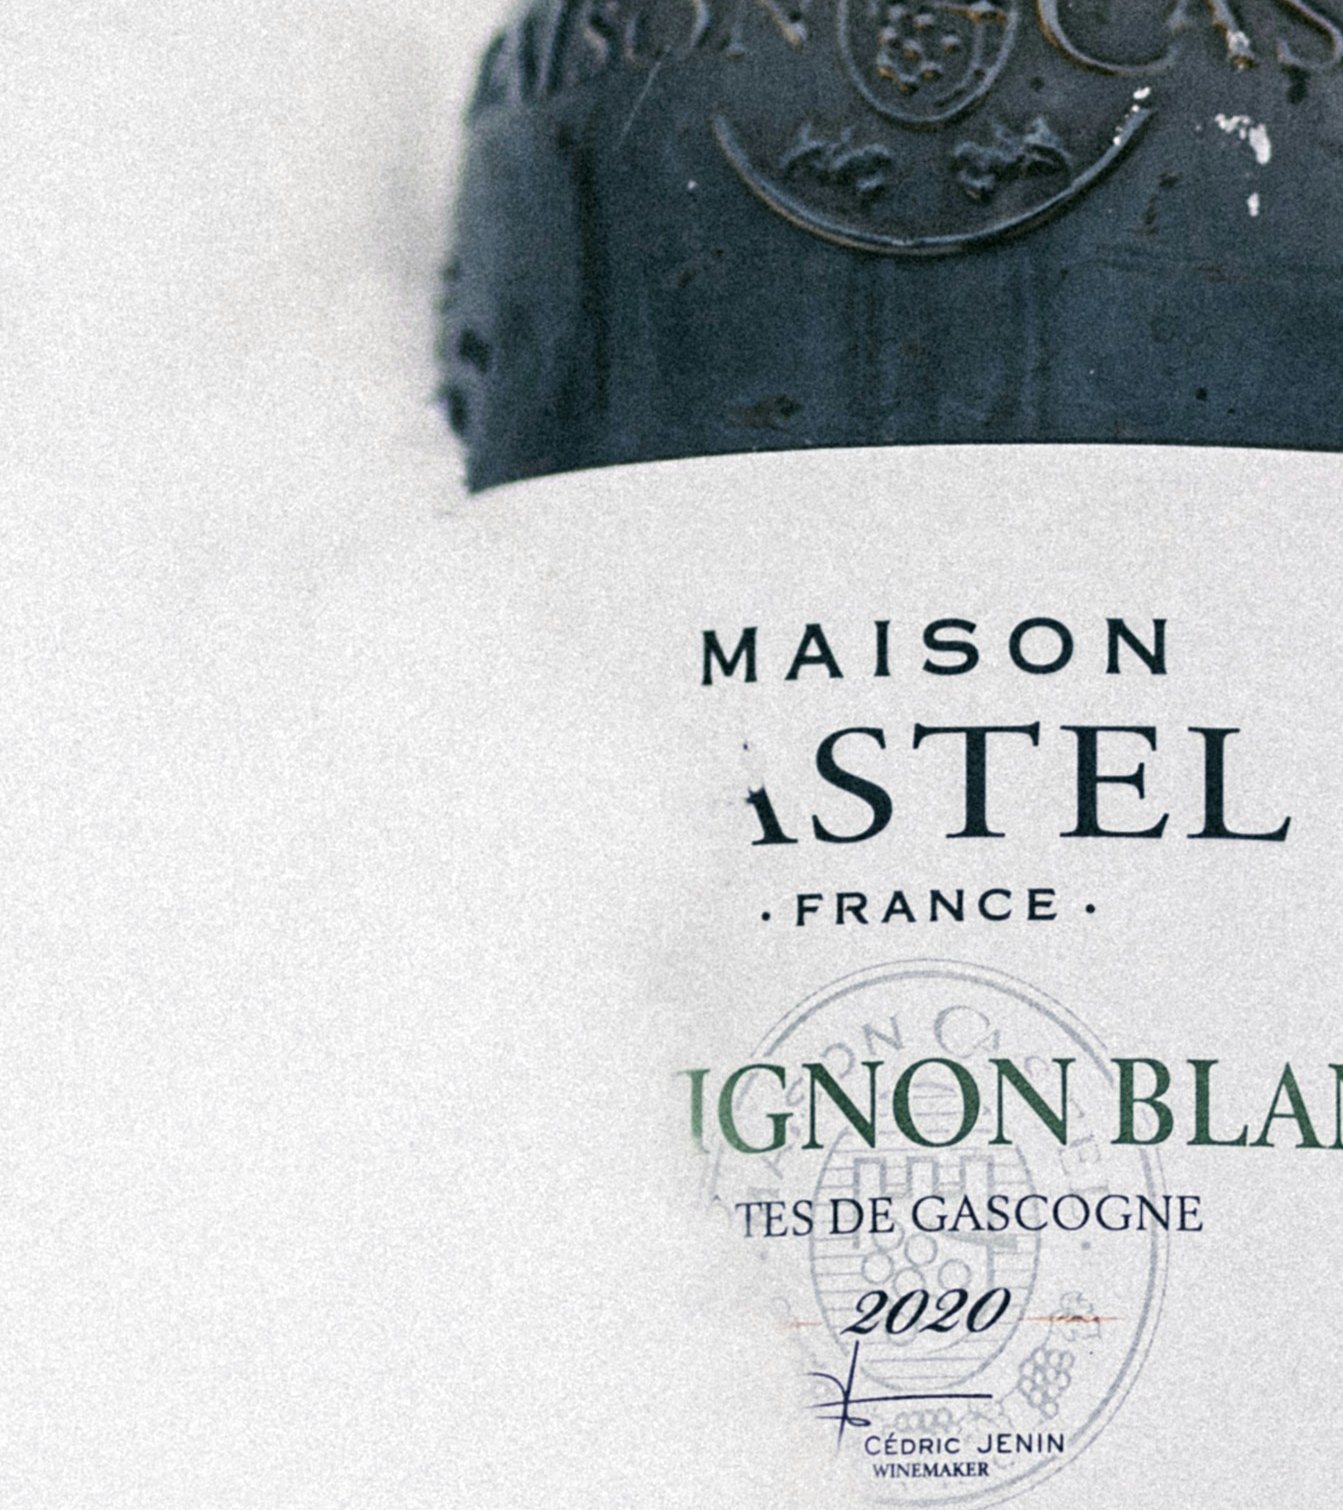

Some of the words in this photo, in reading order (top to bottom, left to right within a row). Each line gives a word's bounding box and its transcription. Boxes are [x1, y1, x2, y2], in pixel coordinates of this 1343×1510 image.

[700, 616, 1169, 687] MAISON
[744, 720, 1292, 847] STEL
[795, 887, 1058, 927] FRANCE
[677, 1057, 1076, 1154] IGNON
[734, 1199, 814, 1238] TES
[829, 1196, 896, 1235] DE
[911, 1193, 1204, 1233] GASCOGNE
[841, 1287, 1012, 1335] 2020
[864, 1432, 960, 1456] CÉDRIC
[977, 1433, 1065, 1454] JENIN
[872, 1461, 990, 1478] WINEMAKER
